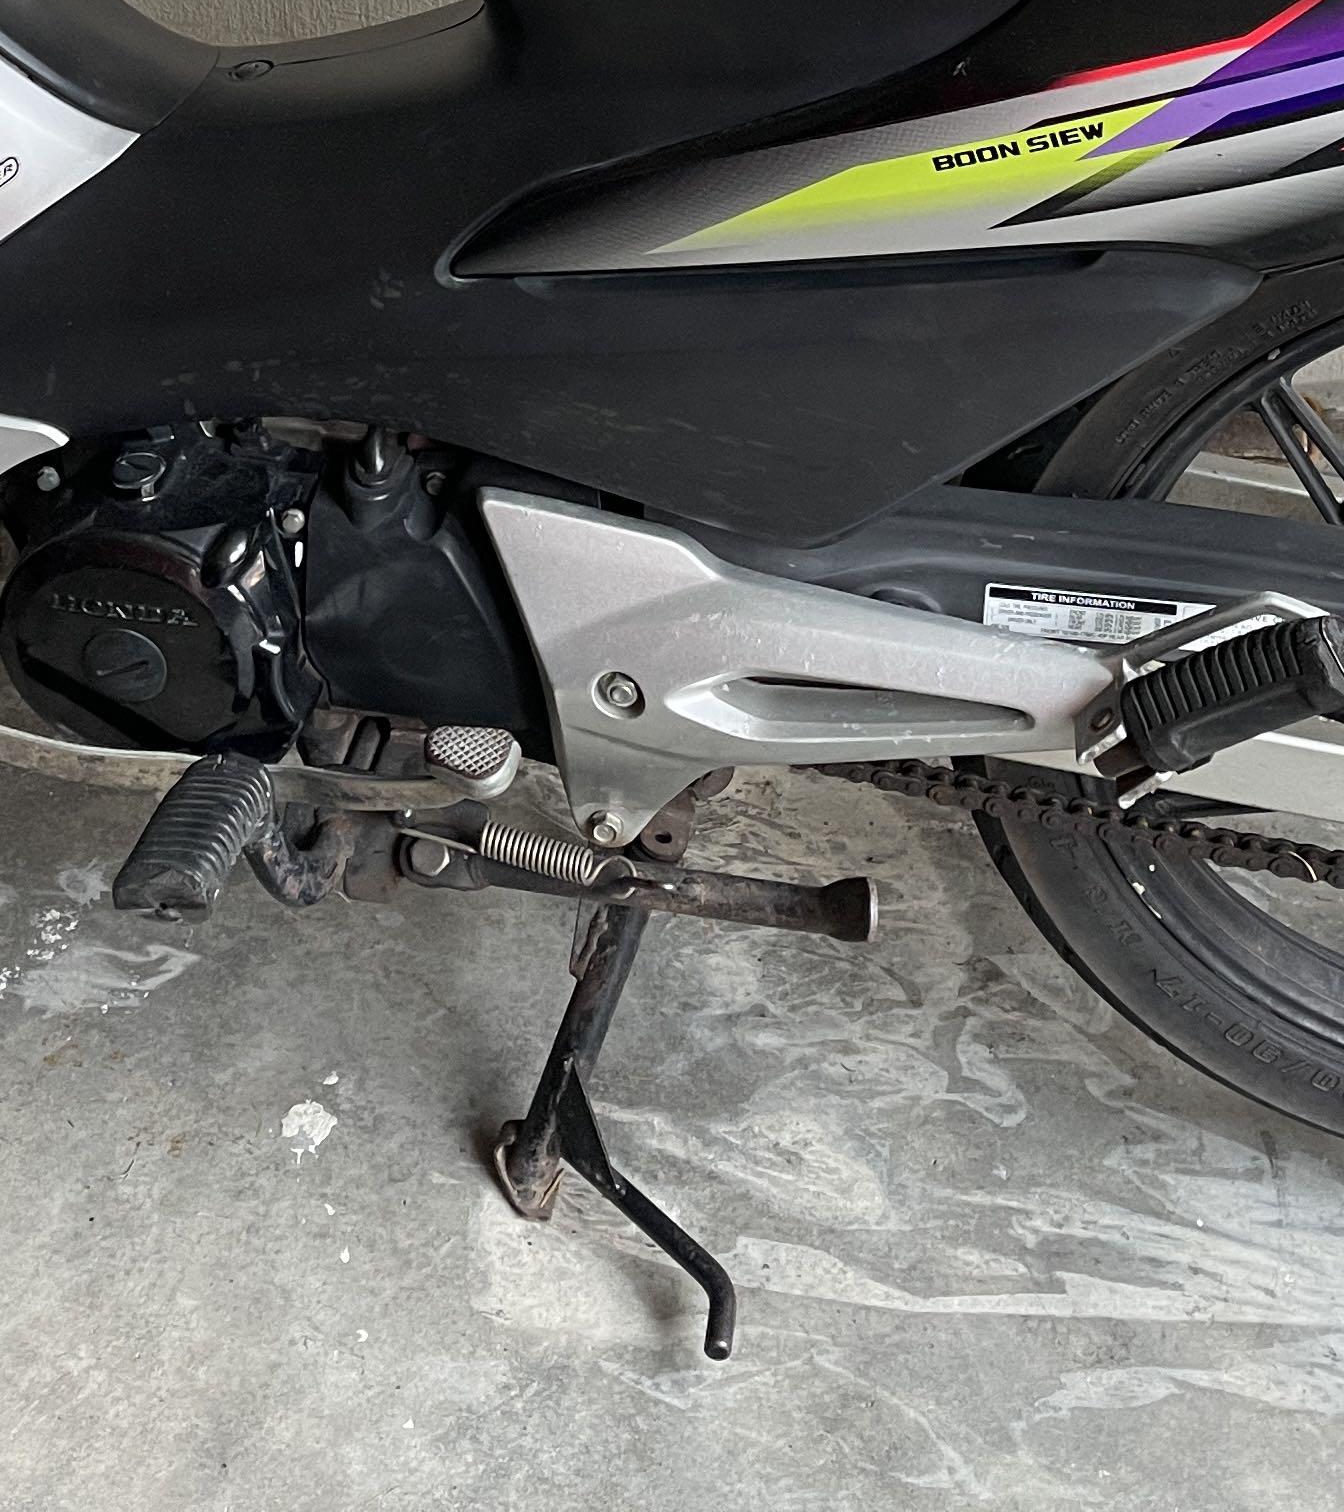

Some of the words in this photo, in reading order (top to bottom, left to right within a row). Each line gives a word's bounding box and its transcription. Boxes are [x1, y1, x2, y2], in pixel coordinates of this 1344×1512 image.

[932, 141, 1021, 172] BOON
[1026, 122, 1104, 153] SIEW
[49, 592, 201, 628] HONDA
[1031, 591, 1057, 603] TIRE
[1058, 593, 1136, 610] INFORMATION
